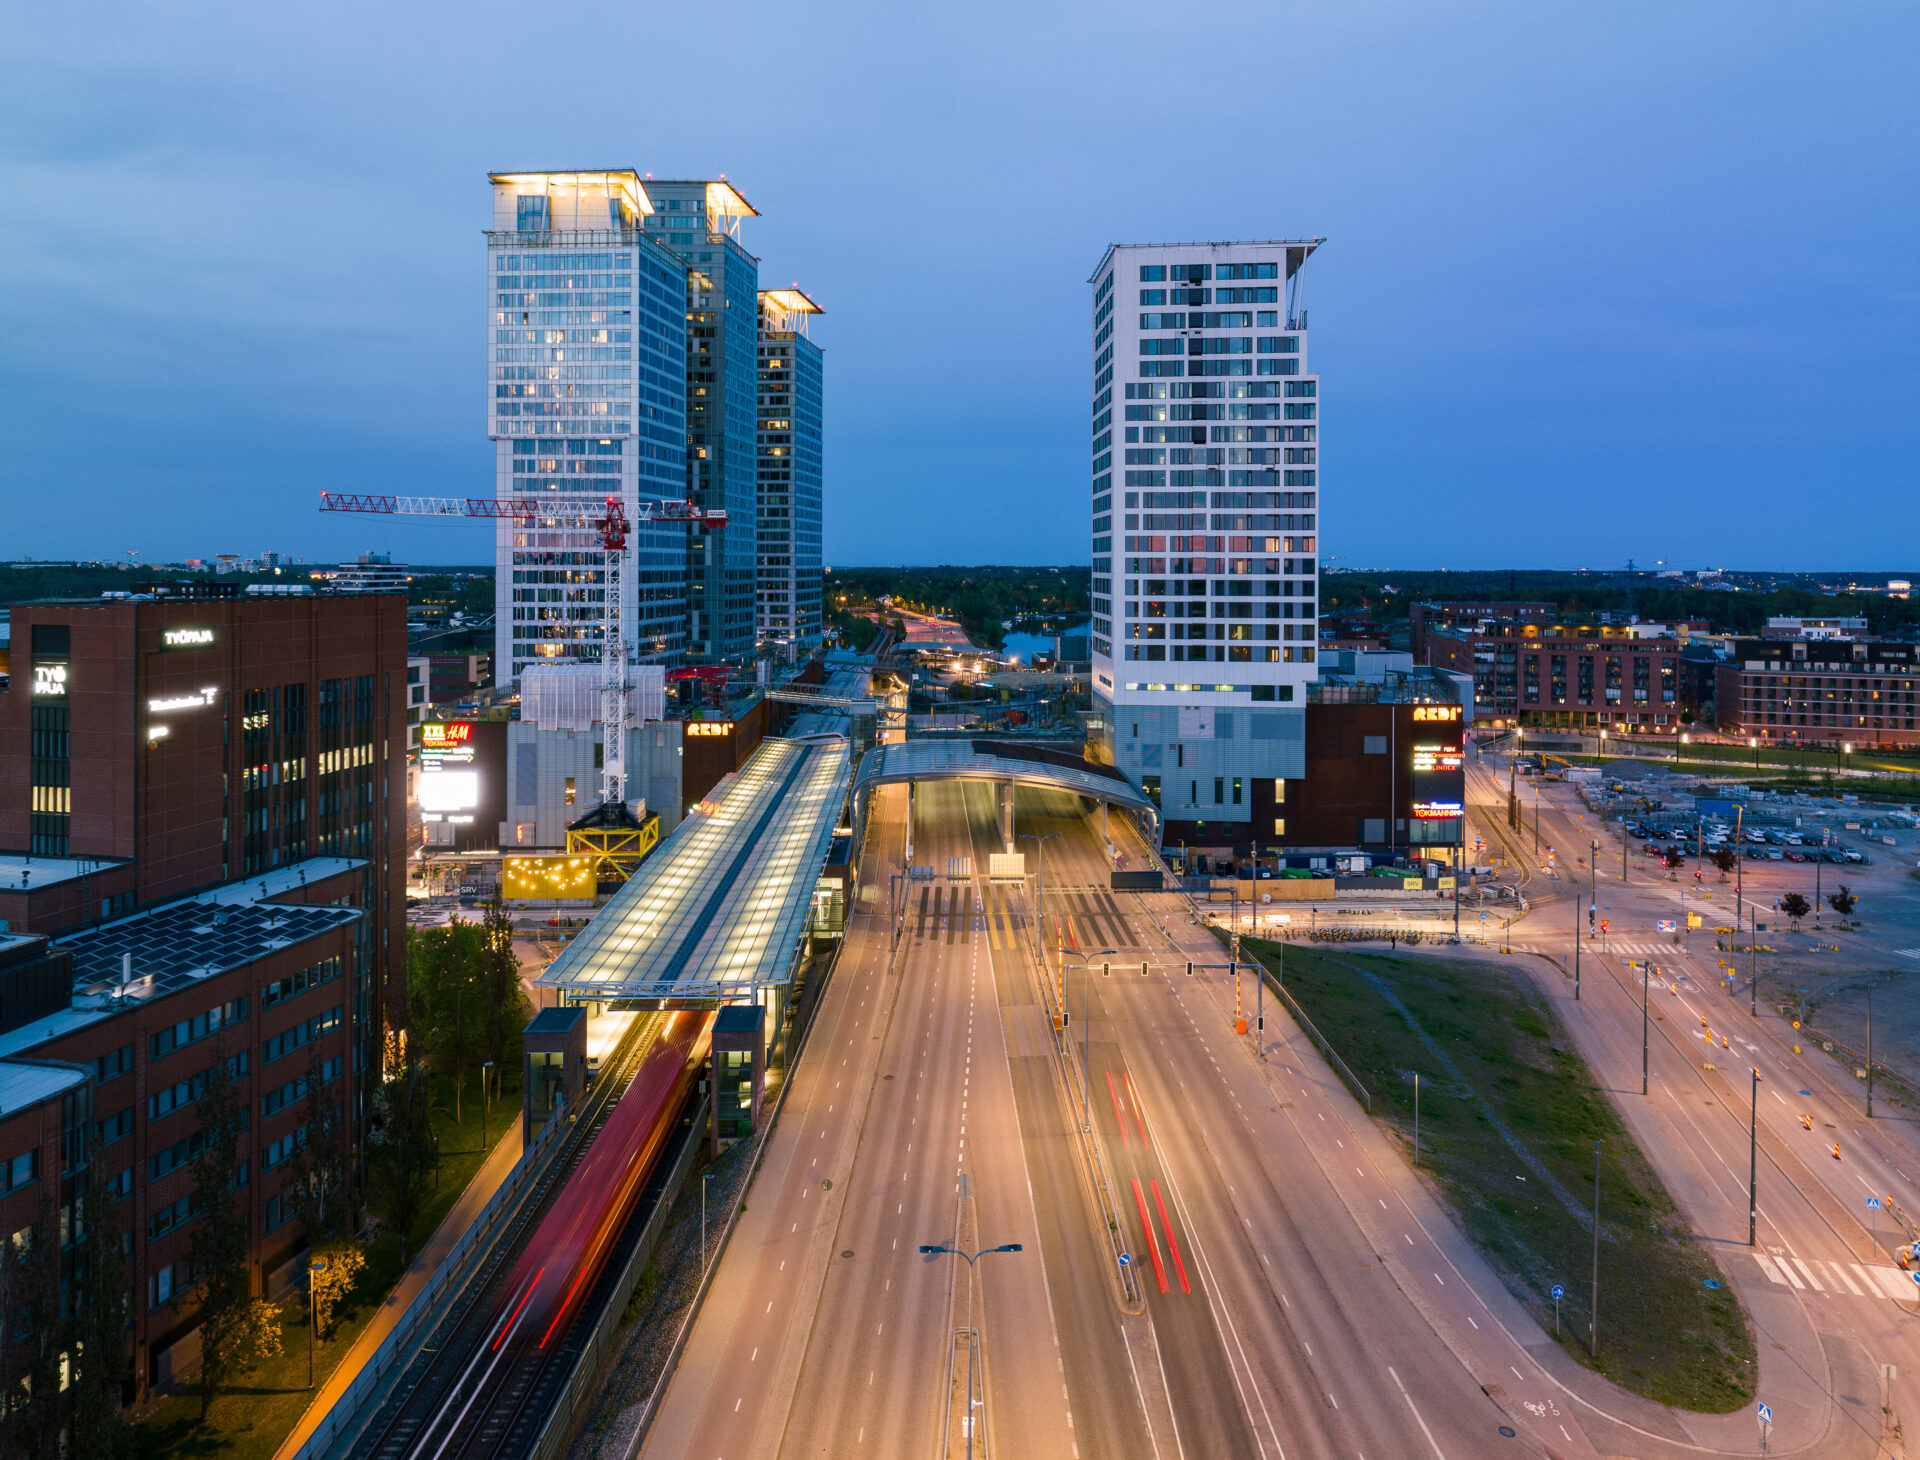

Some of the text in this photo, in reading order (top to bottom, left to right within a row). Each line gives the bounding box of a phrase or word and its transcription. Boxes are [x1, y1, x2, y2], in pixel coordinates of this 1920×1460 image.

[164, 630, 214, 645] TYÖPAJA
[35, 666, 66, 682] TYÖ
[35, 682, 65, 694] PAJA
[1413, 707, 1457, 720] REDI
[423, 725, 470, 740] XXL H&M
[687, 723, 729, 736] REDI
[460, 886, 477, 894] SRV
